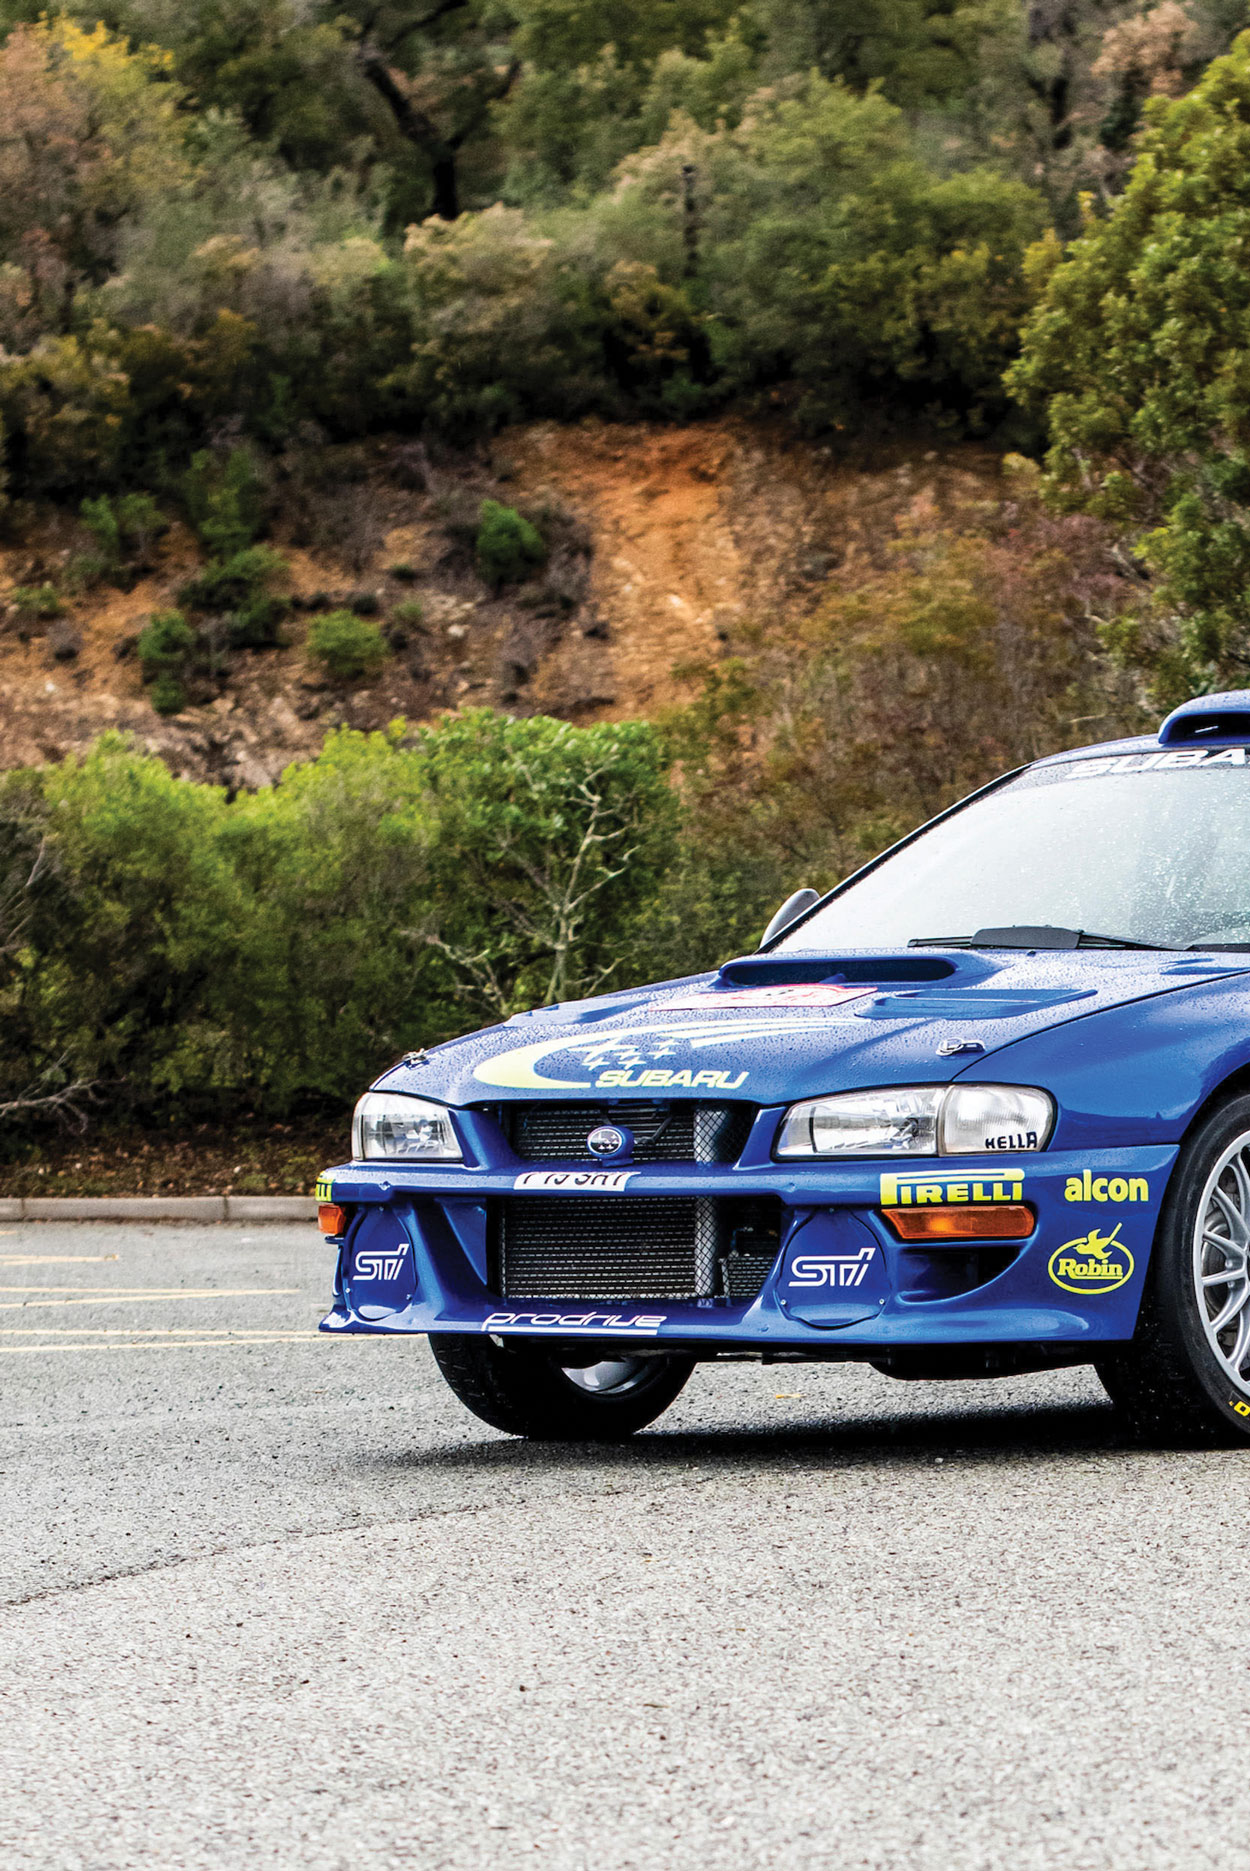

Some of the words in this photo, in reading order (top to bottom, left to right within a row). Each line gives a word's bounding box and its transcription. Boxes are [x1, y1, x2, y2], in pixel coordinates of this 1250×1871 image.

[595, 1070, 750, 1089] SUBARU
[985, 1131, 1037, 1150] HELLA
[880, 1168, 1025, 1205] PIRELLI
[1064, 1169, 1148, 1202] alcon
[1057, 1258, 1123, 1278] Robin
[481, 1312, 667, 1331] prodrive
